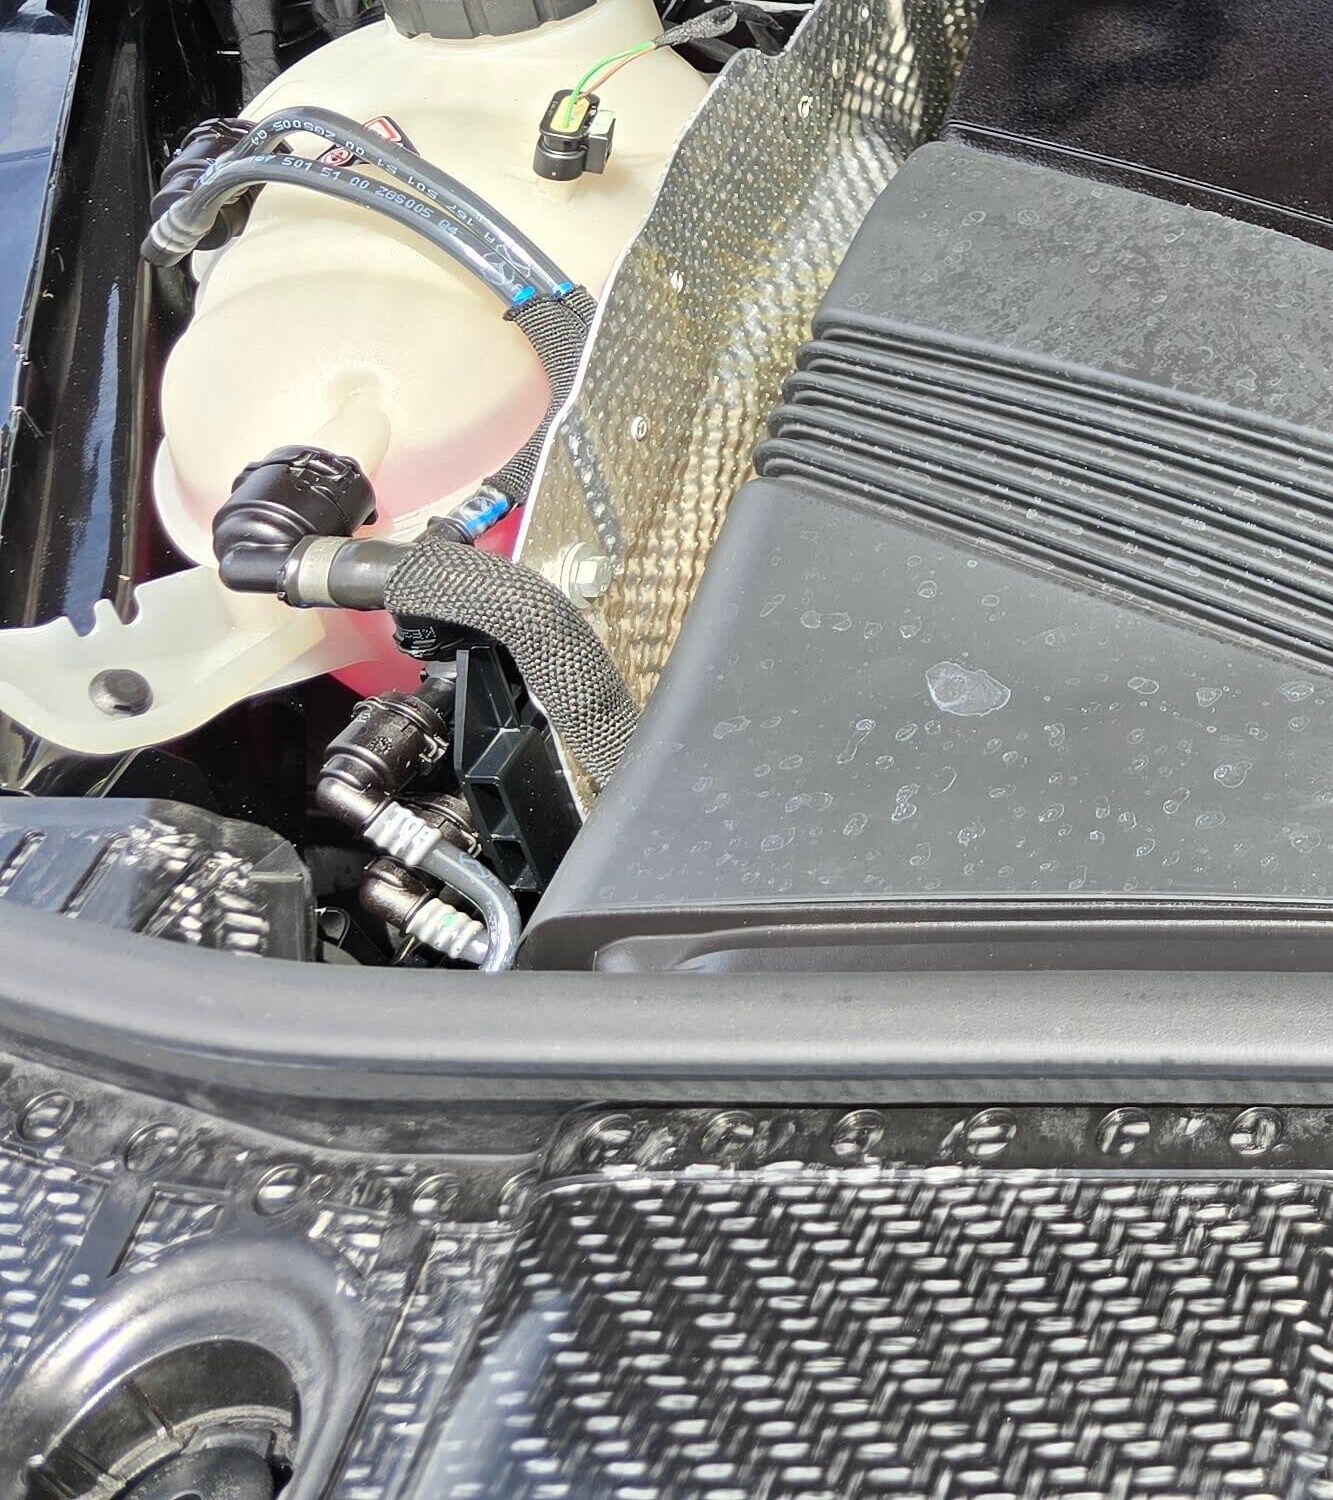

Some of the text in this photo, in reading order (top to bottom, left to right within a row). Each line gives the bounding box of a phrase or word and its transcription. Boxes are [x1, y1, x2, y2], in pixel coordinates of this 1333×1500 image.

[281, 155, 313, 173] 501
[320, 166, 342, 181] 51
[349, 176, 370, 190] 00
[377, 158, 398, 175] 51
[407, 176, 439, 199] 501
